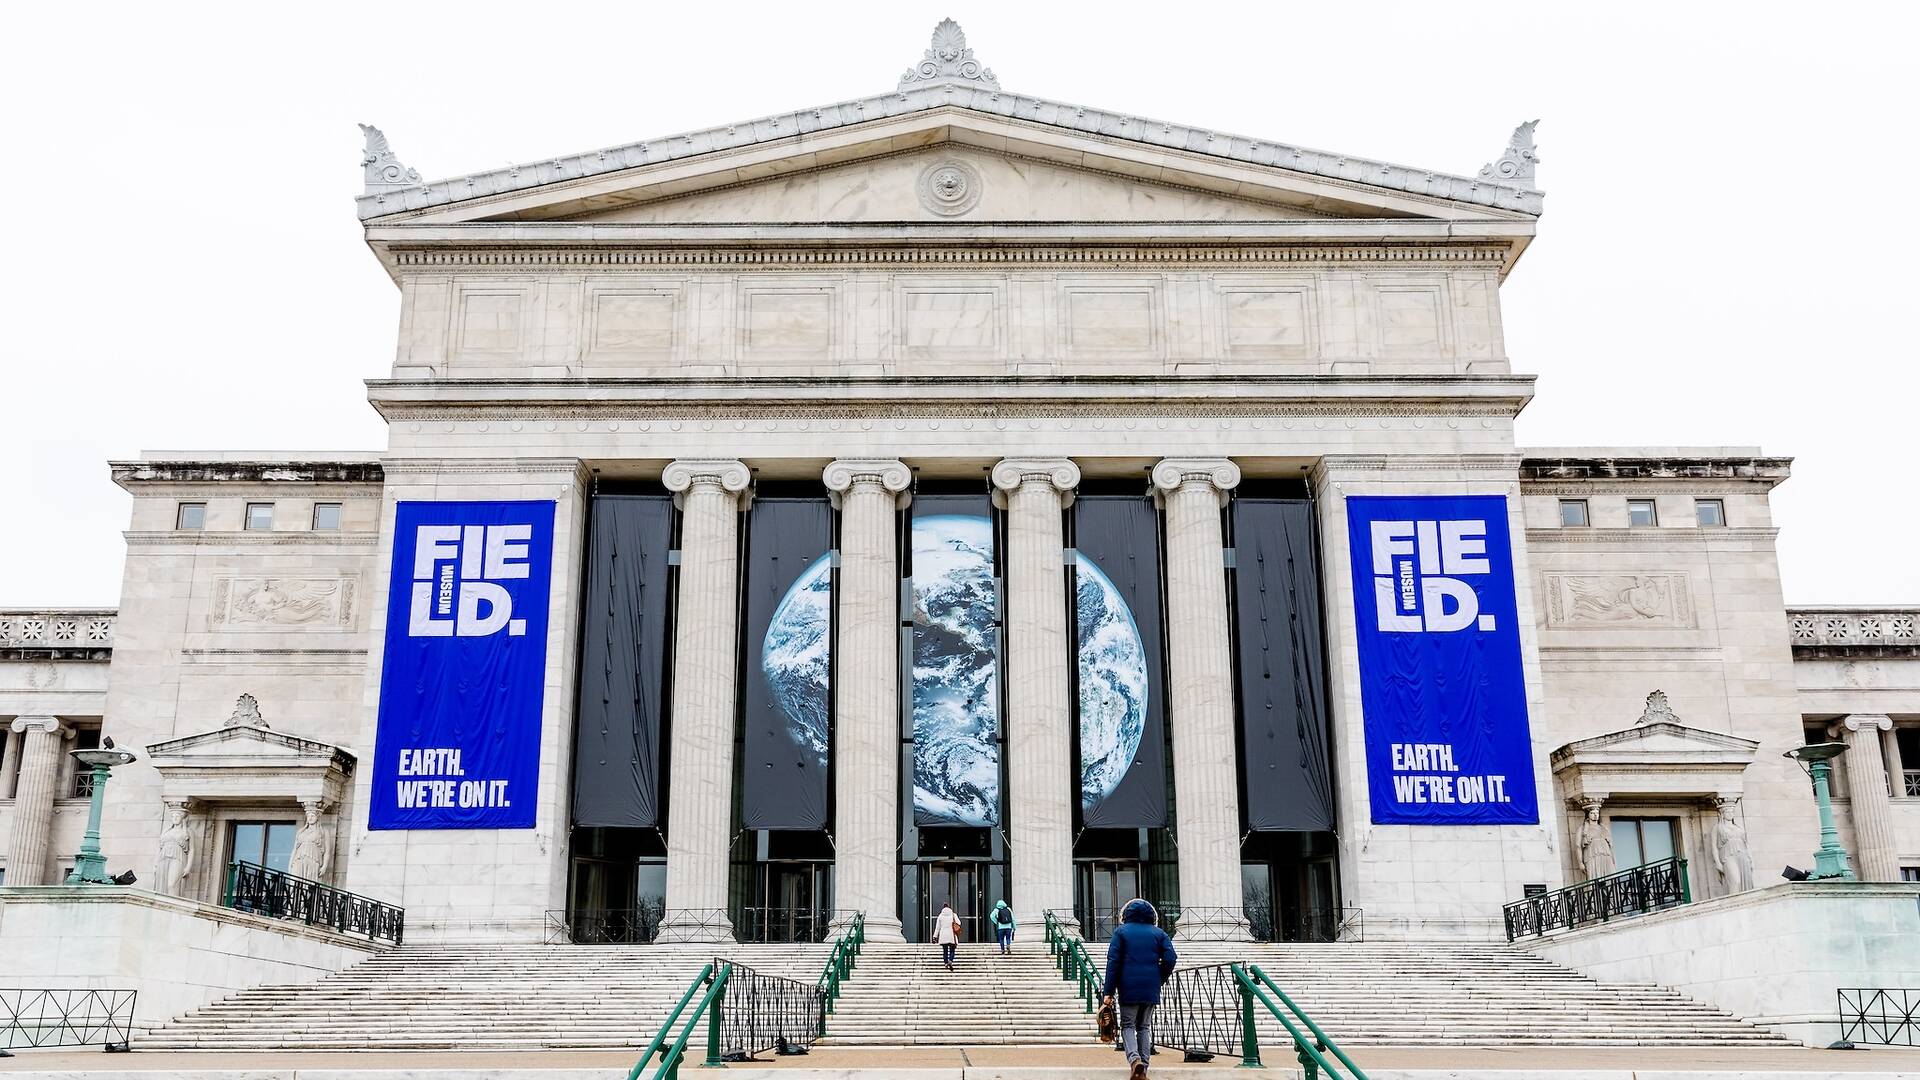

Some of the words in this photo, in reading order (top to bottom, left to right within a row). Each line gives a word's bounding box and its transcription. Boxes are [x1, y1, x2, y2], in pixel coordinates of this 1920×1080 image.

[413, 524, 532, 580] FIE
[1370, 519, 1490, 575] FIE
[408, 581, 527, 637] LD.
[438, 564, 454, 614] MUSEUM
[1374, 576, 1496, 632] LD.
[1399, 560, 1416, 610] MUSEUM
[398, 748, 465, 776] EARTH.
[1391, 743, 1459, 772] EARTH.
[397, 780, 457, 808] WE'RE
[458, 780, 487, 808] ON
[488, 780, 511, 808] IT.
[1393, 775, 1456, 803] WE'RE
[1456, 775, 1486, 804] ON
[1486, 775, 1511, 803] IT.
